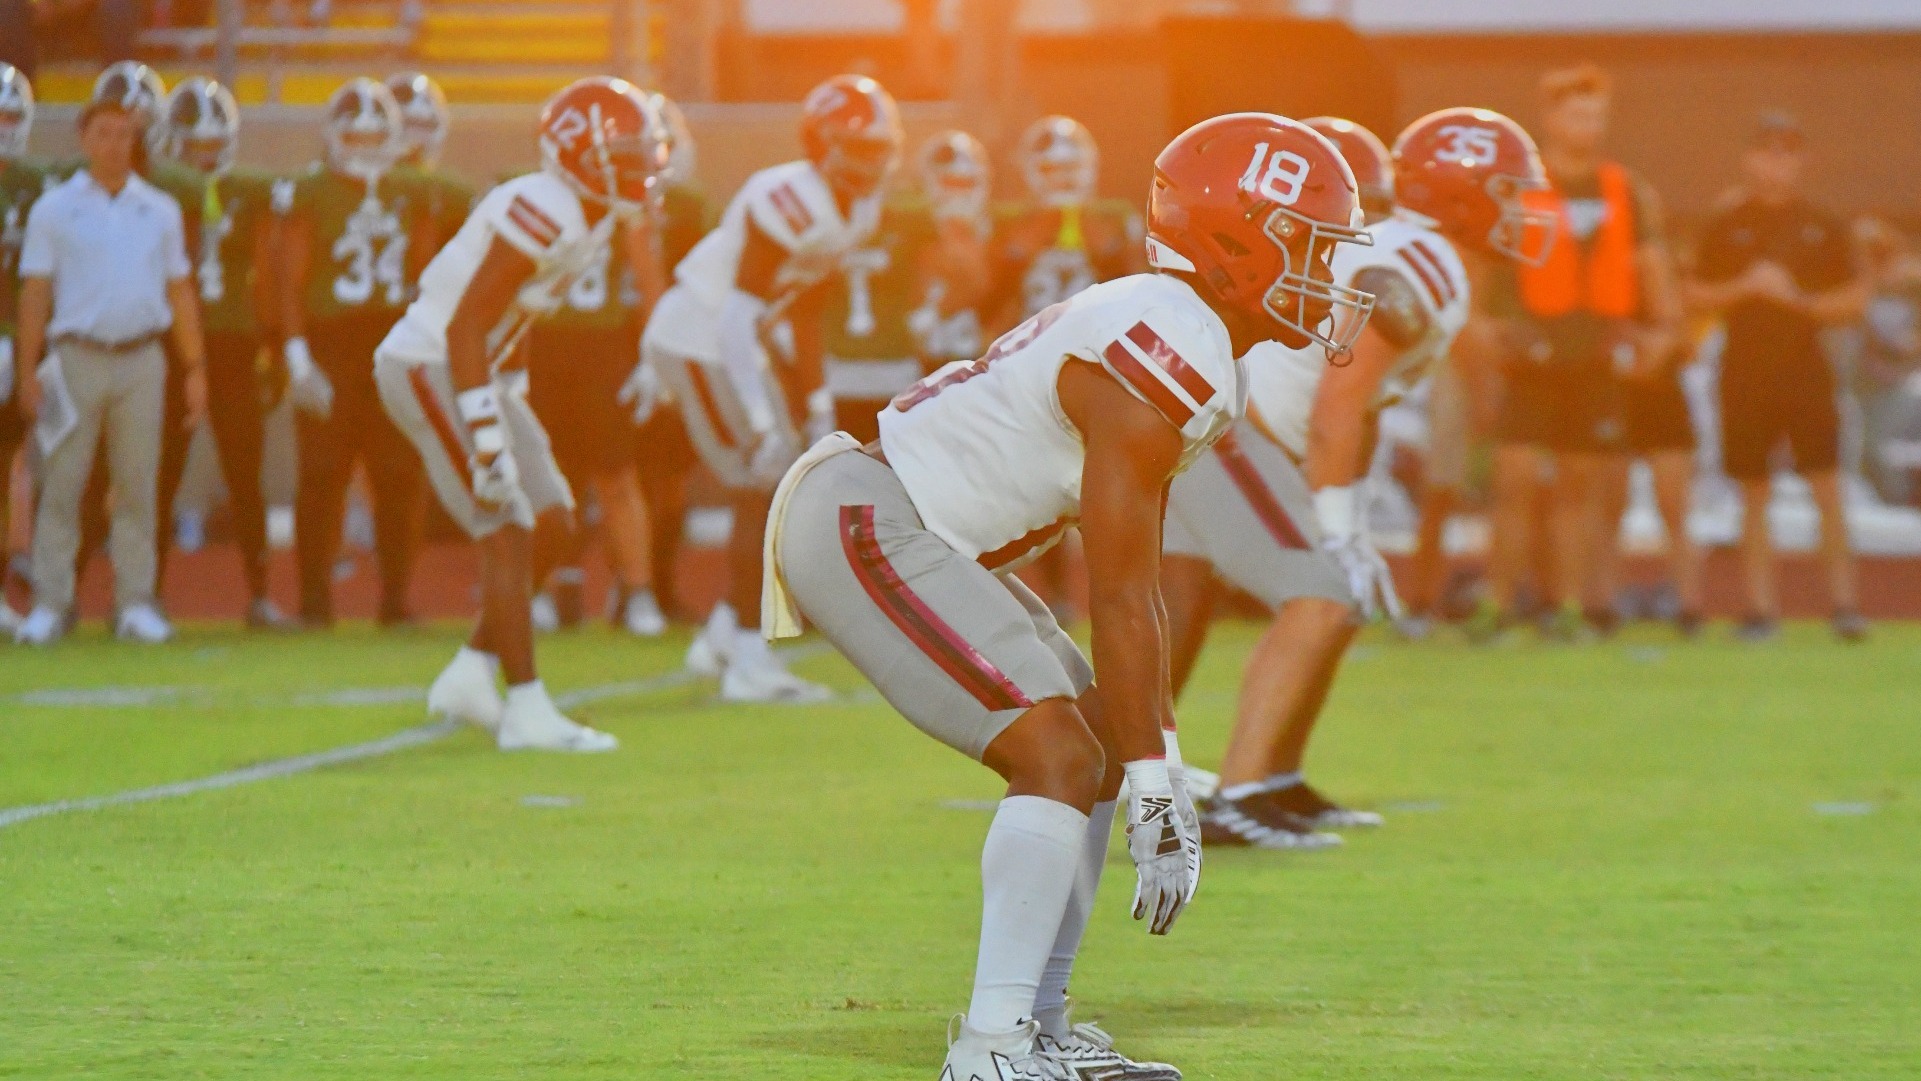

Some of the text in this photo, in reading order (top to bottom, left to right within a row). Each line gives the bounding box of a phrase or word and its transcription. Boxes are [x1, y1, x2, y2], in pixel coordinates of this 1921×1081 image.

[1237, 142, 1310, 205] 18
[1436, 126, 1497, 166] 35
[332, 233, 408, 304] 34
